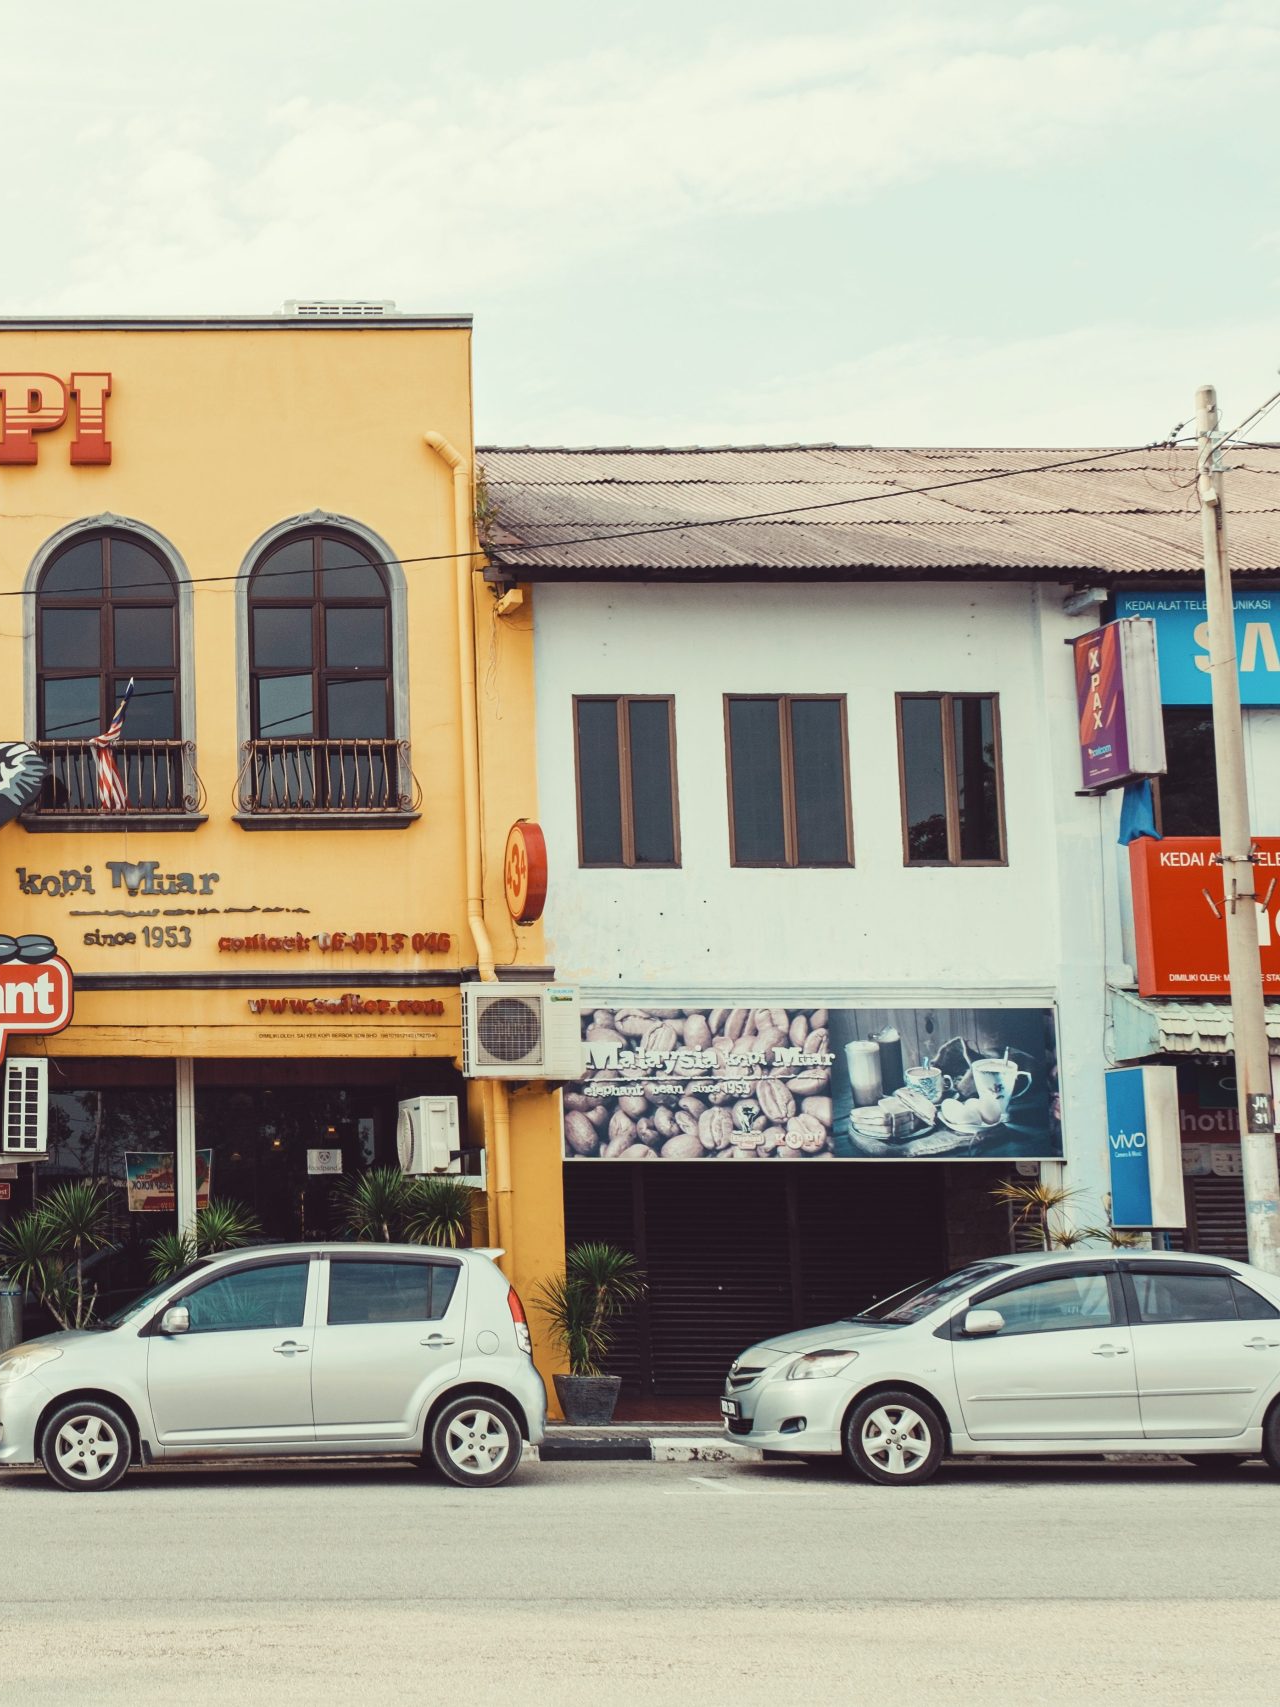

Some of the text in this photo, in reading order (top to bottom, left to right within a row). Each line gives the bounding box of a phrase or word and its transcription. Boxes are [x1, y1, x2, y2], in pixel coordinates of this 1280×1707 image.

[1125, 599, 1271, 611] KEDAI ALAT TELEUNIKASI
[1088, 648, 1103, 731] XPAX
[507, 843, 526, 897] 434
[1160, 852, 1204, 867] KEDAI
[16, 861, 219, 897] kopi Muar
[83, 925, 192, 948] since 1953
[218, 933, 310, 953] contact:
[411, 932, 451, 953] 046
[583, 1042, 835, 1073] Malaysia kopi Muar
[584, 1084, 644, 1098] elephant
[653, 1084, 685, 1094] bean
[1255, 1113, 1267, 1124] 31
